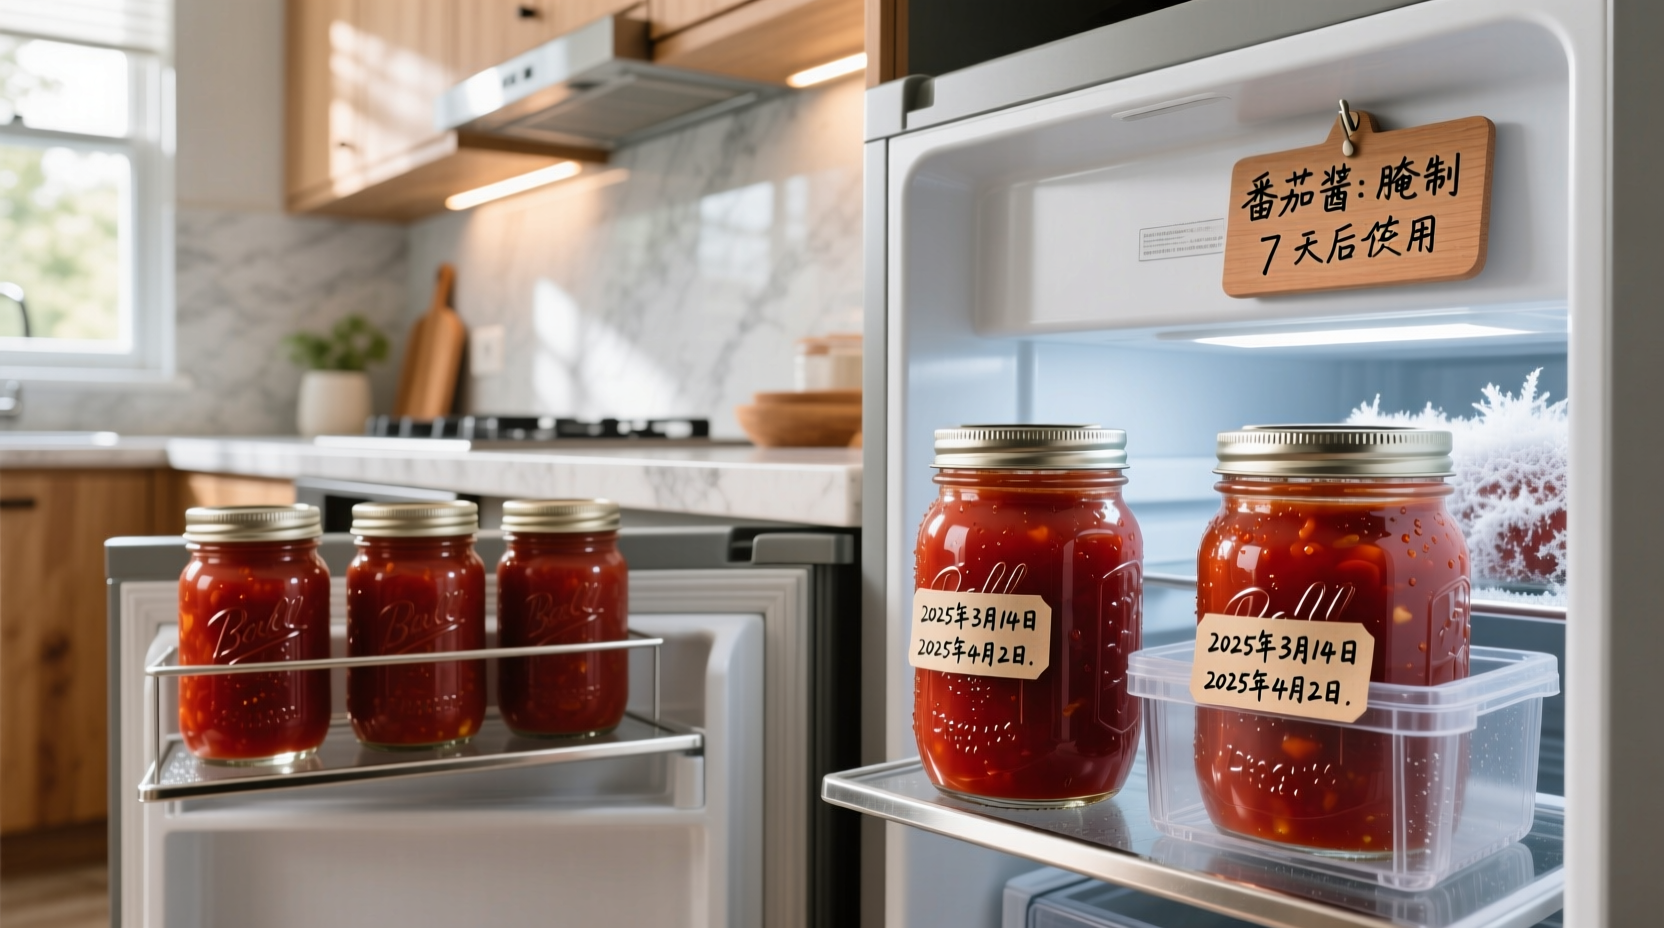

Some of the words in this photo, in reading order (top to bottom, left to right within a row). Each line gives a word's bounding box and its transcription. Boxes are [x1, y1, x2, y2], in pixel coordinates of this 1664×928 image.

[920, 601, 1037, 632] 2025年3月14日
[1207, 630, 1357, 666] 2025年3月14日
